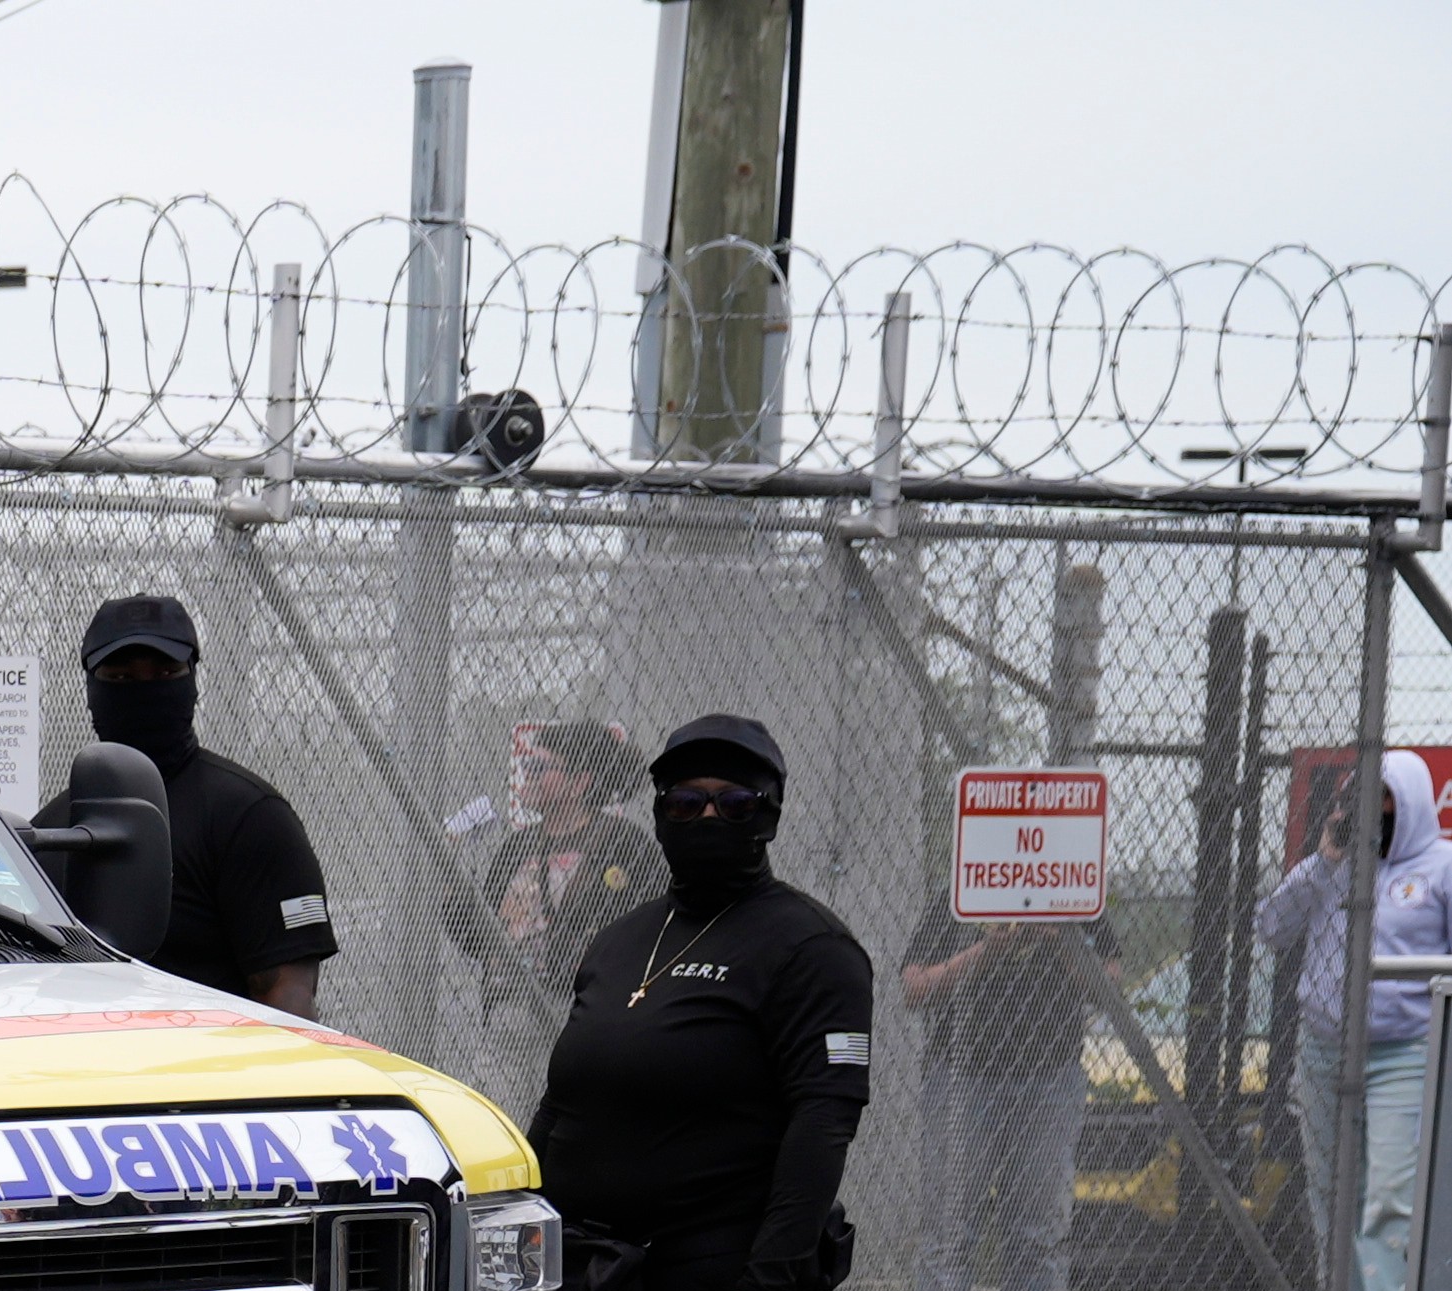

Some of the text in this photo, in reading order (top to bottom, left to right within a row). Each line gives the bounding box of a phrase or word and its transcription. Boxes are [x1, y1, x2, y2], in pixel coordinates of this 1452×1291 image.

[965, 780, 1101, 810] PRIVATE PROPERTY
[1016, 827, 1044, 854] NO
[964, 862, 1098, 889] TRESPASSING
[671, 962, 729, 982] C.E.R.T.
